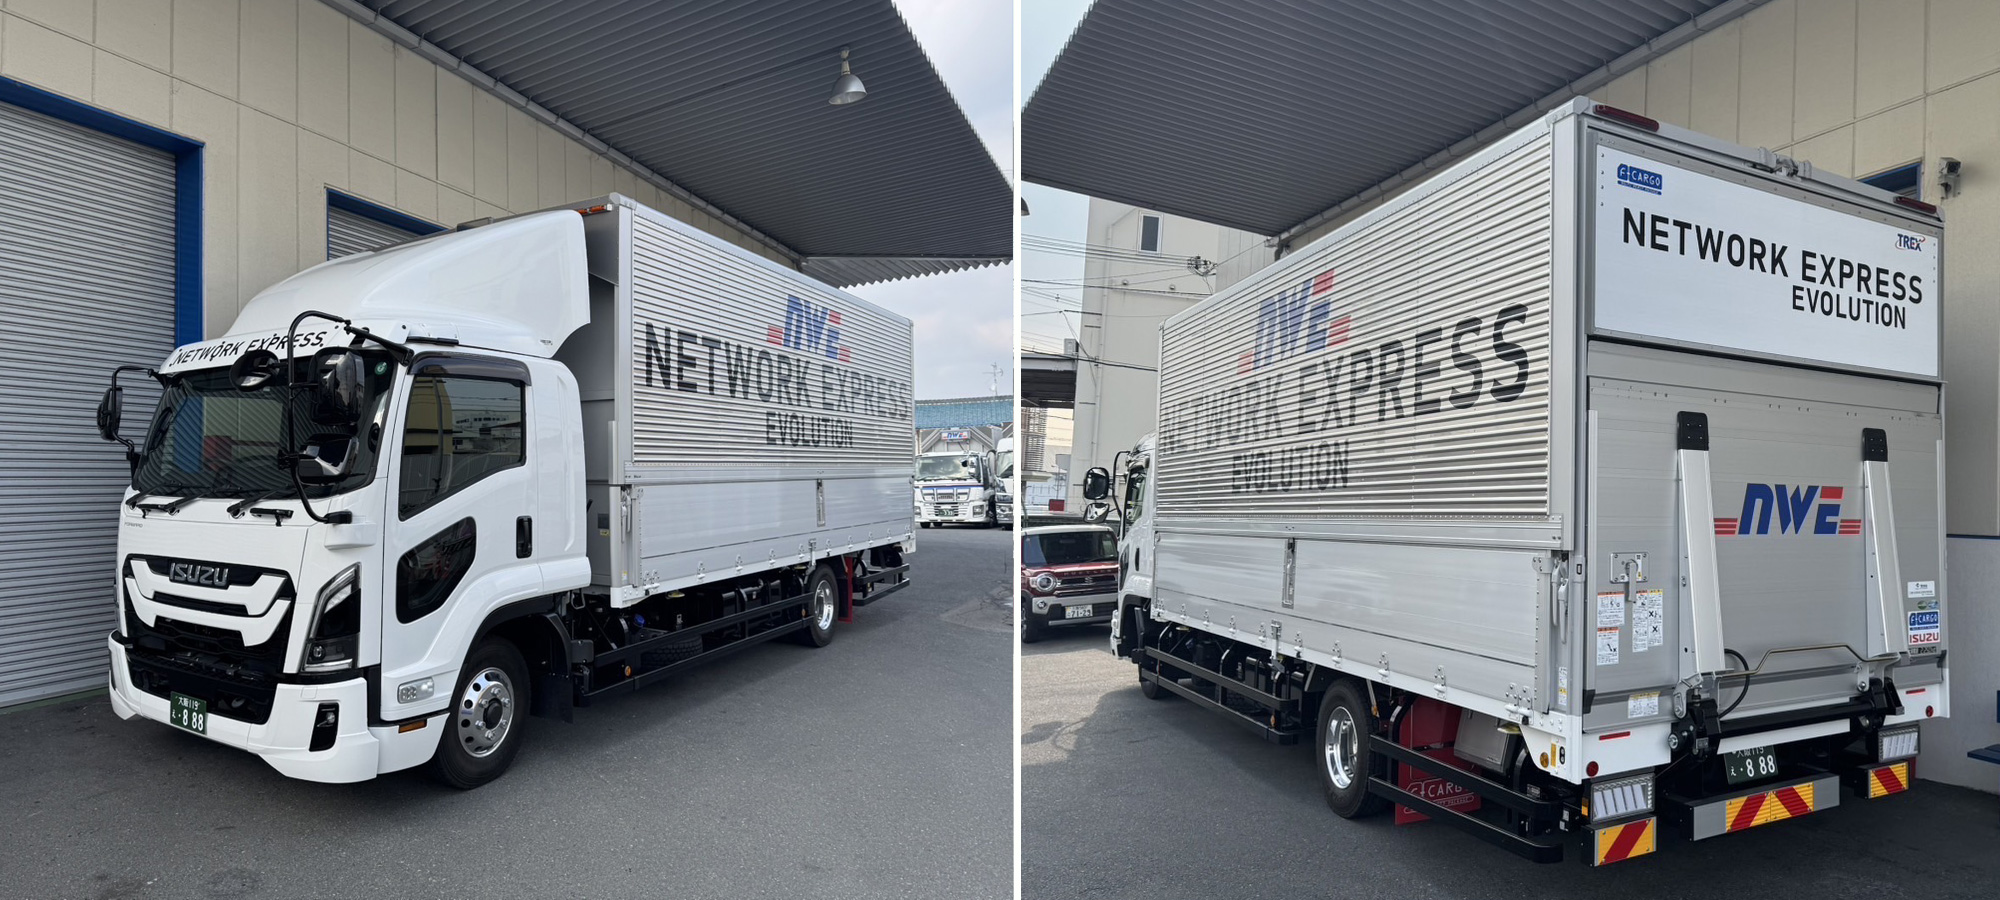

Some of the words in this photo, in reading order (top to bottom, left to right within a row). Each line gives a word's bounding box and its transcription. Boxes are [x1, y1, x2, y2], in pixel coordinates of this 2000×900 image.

[1622, 207, 1789, 278] NETWORK
[1801, 250, 1923, 304] EXPRESS
[1792, 285, 1906, 330] EVOLUTION
[173, 341, 245, 365] NETWORK
[645, 321, 812, 409] NETWORK
[821, 364, 909, 421] EXPRESS
[1162, 374, 1284, 456] NETWORK
[1298, 302, 1529, 435] EXPRESS
[766, 410, 853, 448] EVOLUTION
[1231, 440, 1350, 494] EVOLUTION
[1738, 483, 1843, 535] NWE
[169, 562, 229, 587] ISUZU
[1909, 632, 1939, 644] ISUZU
